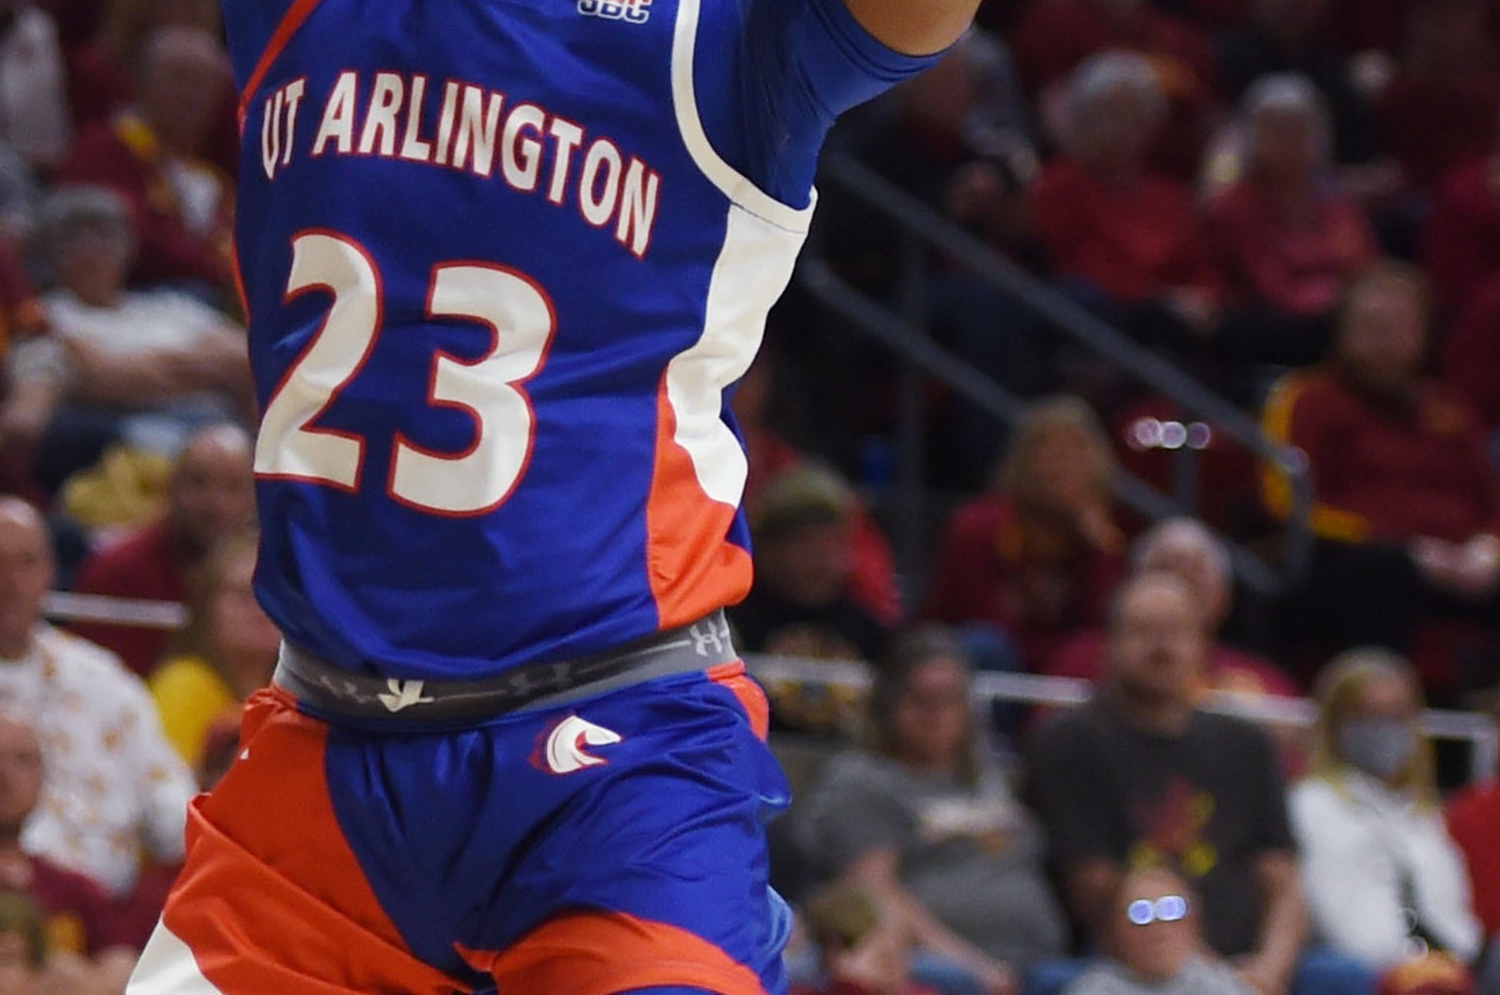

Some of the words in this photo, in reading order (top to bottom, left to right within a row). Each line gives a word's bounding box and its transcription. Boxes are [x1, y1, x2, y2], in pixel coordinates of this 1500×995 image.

[260, 77, 306, 182] UT
[310, 69, 661, 260] ARLINGTON
[253, 227, 558, 519] 23
